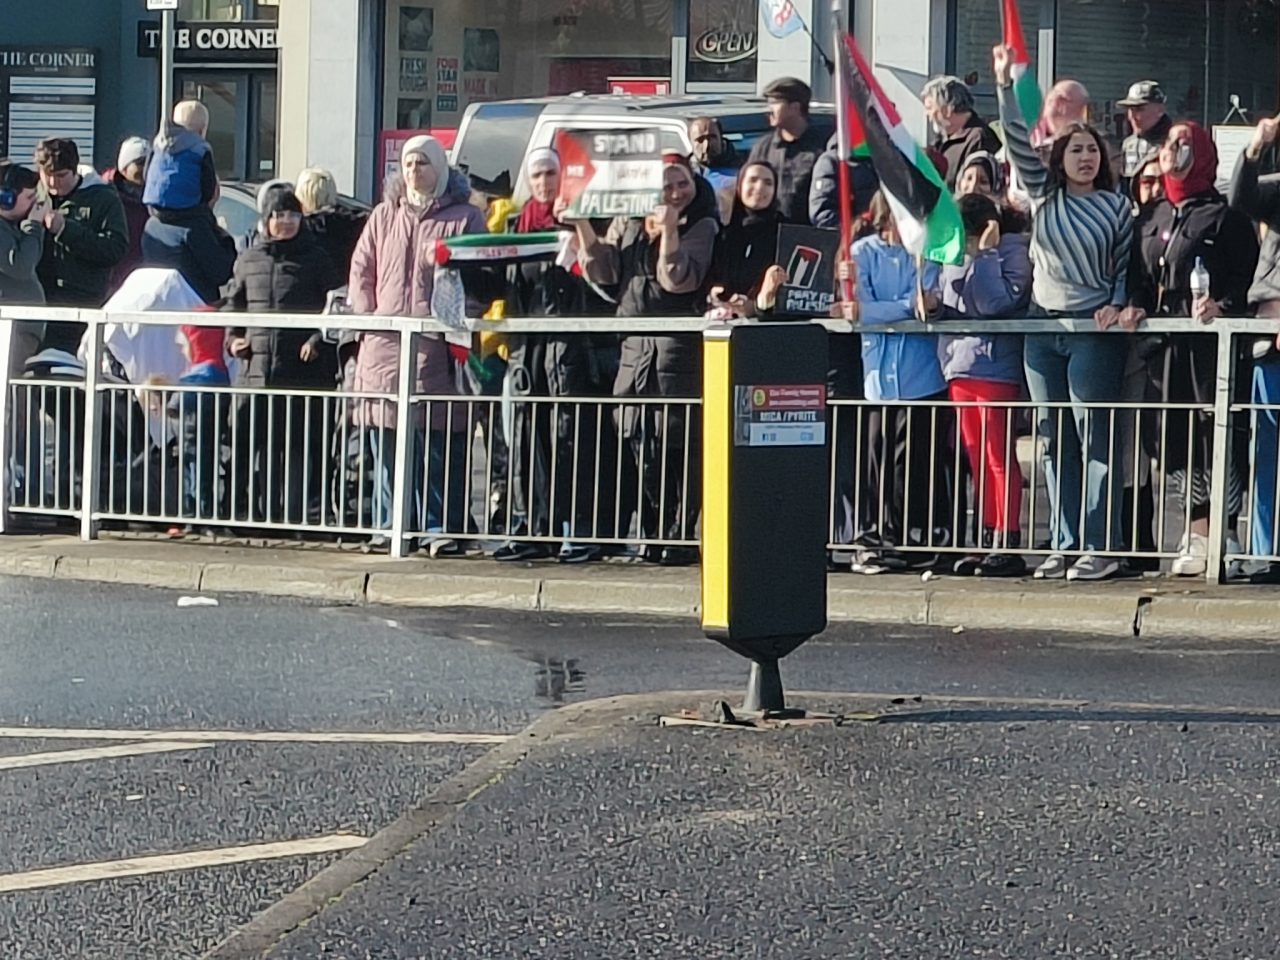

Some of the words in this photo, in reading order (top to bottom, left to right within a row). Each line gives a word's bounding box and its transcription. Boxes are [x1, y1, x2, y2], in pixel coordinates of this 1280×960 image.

[196, 28, 279, 49] CORNE
[29, 52, 95, 67] CORNER
[594, 133, 655, 154] STAND
[580, 193, 658, 214] PALESTINE
